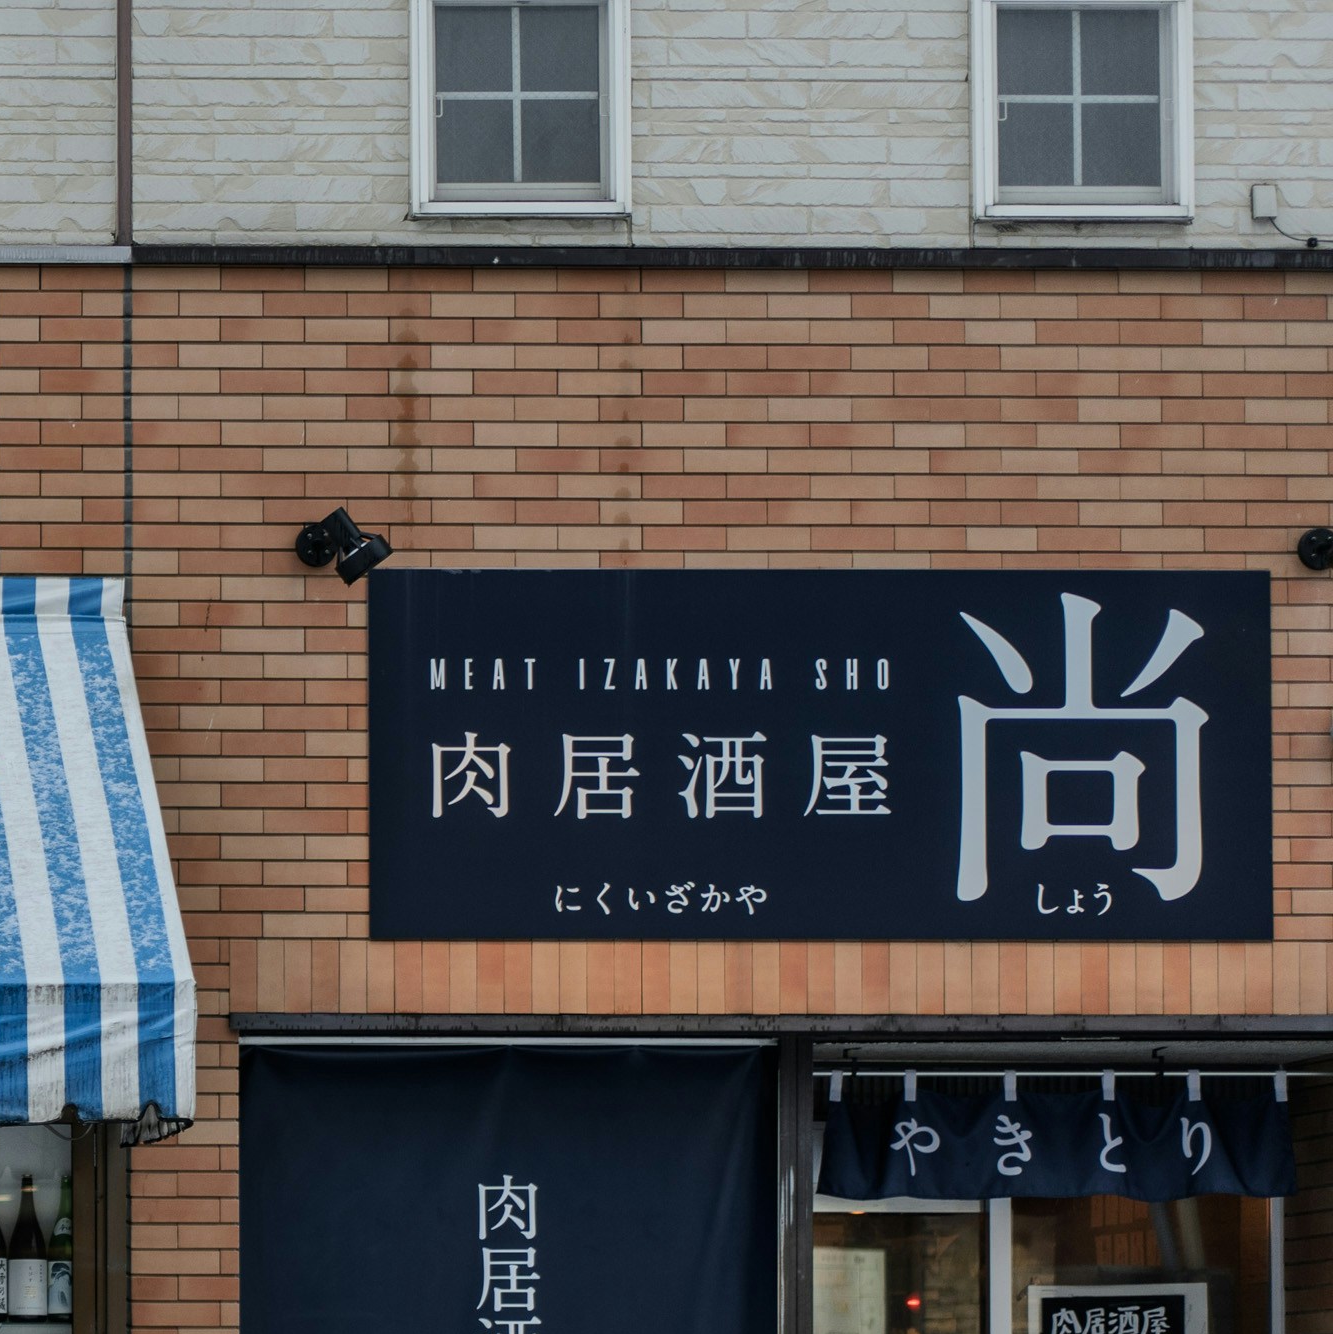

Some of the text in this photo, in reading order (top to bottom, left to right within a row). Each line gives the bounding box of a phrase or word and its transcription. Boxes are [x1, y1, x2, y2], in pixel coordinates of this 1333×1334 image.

[430, 657, 893, 691] MEAT IZAKAYA SHO
[957, 591, 1209, 903] 尚
[430, 731, 892, 819] 肉居酒屋
[554, 880, 767, 917] にくいざかや
[1036, 884, 1113, 917] しょう
[890, 1113, 1213, 1176] やきとり
